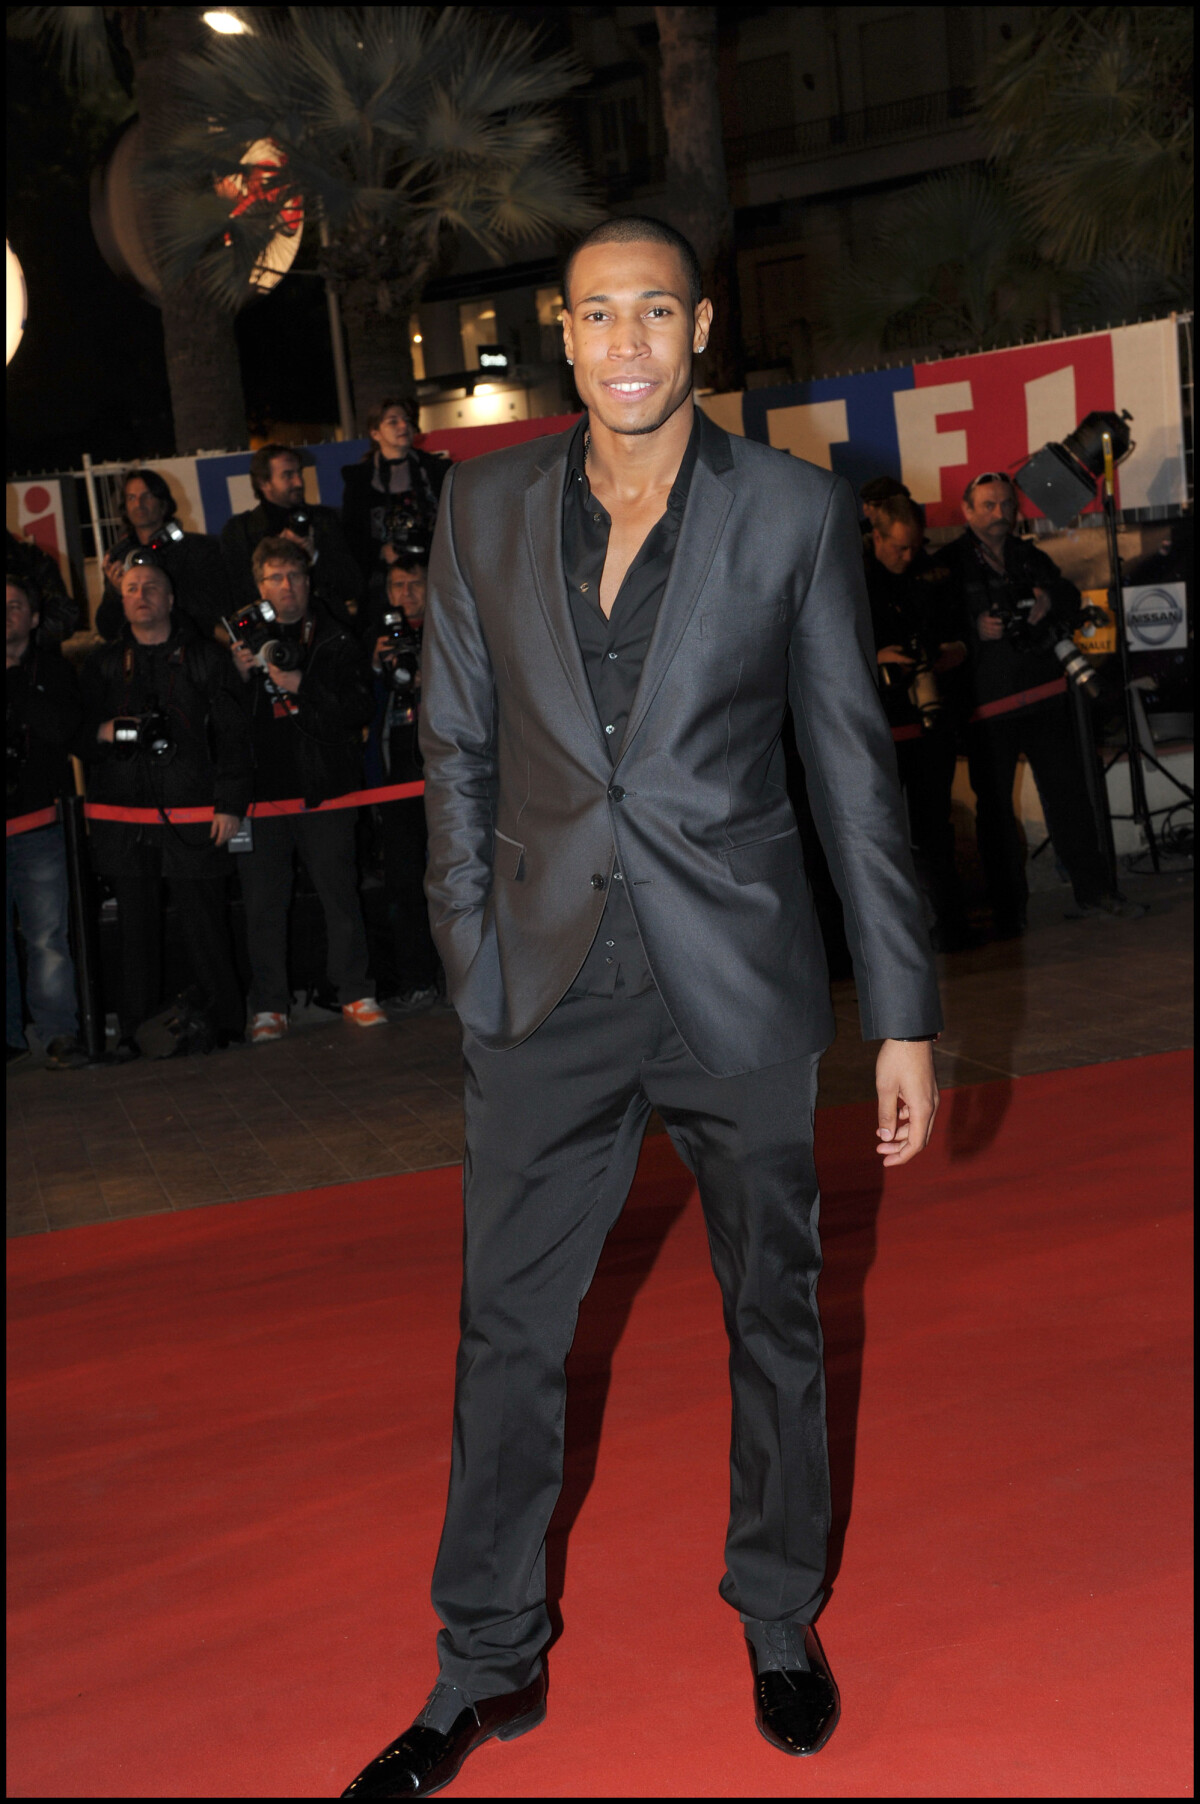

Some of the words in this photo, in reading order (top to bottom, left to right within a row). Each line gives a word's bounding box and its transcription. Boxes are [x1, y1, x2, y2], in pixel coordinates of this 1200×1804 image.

[766, 365, 1078, 504] TF1
[1131, 611, 1178, 622] NISSAN
[1080, 640, 1111, 650] NAULT
